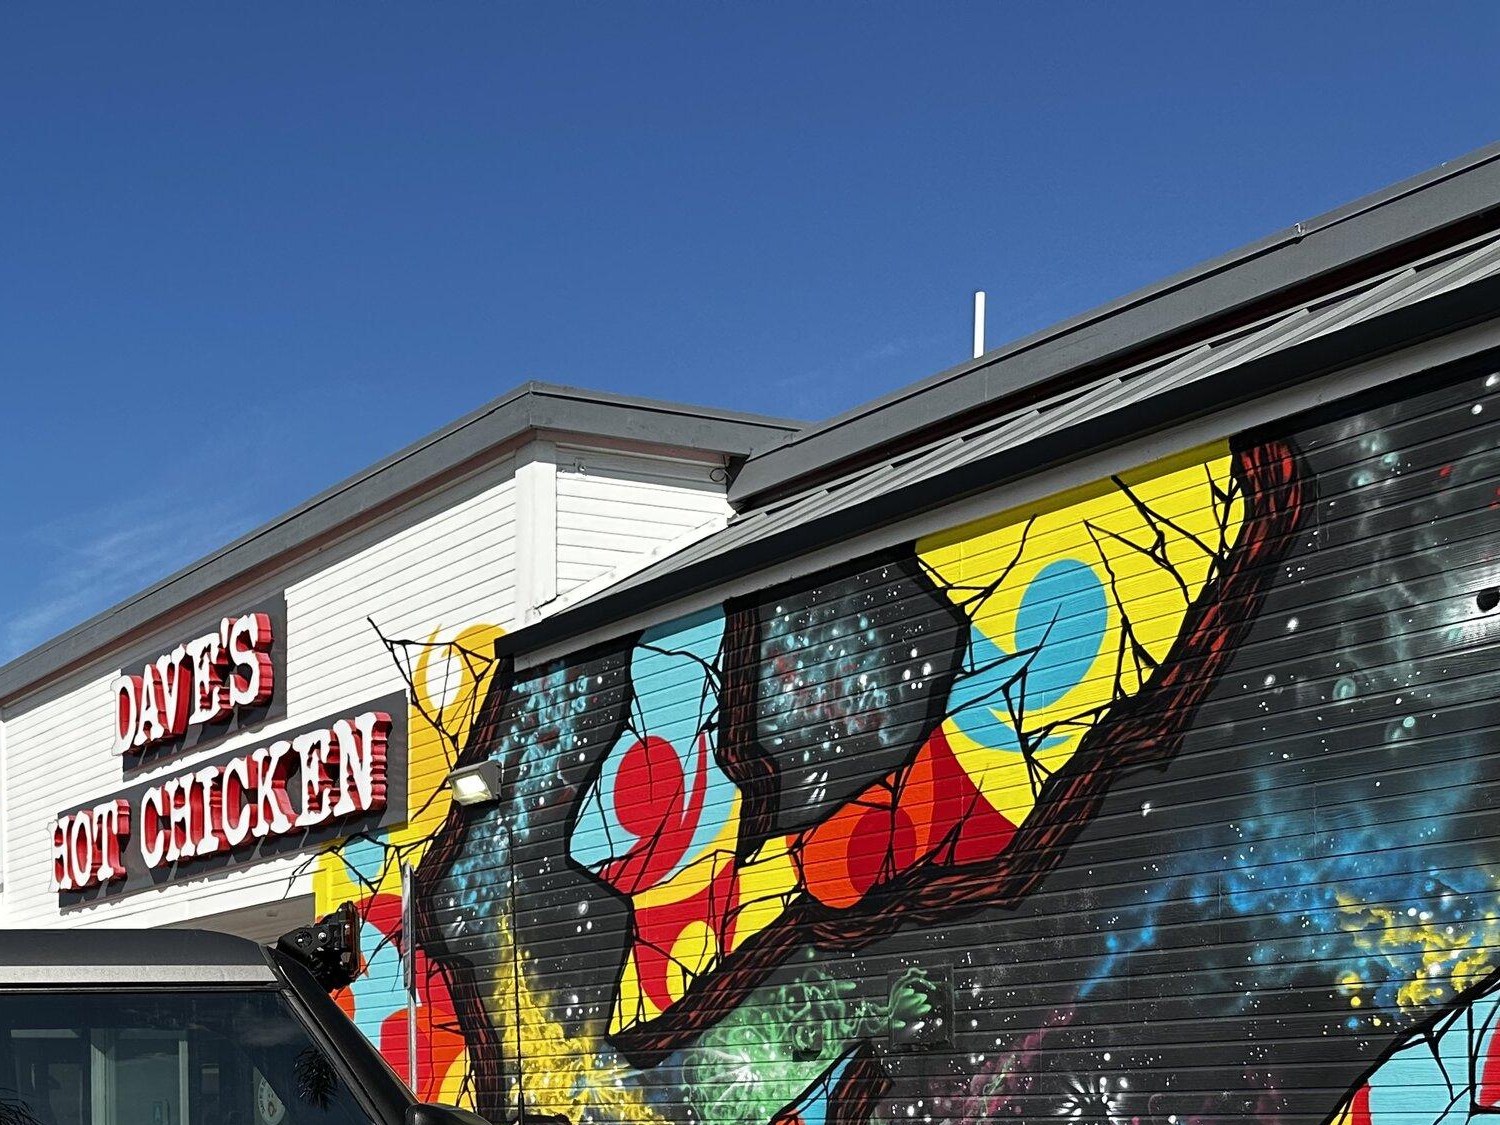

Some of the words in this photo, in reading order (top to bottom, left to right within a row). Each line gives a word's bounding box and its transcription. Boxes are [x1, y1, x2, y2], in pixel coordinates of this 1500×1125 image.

[110, 613, 272, 756] DAVE'S
[48, 799, 129, 893] HOT
[140, 711, 389, 869] CHICKEN
